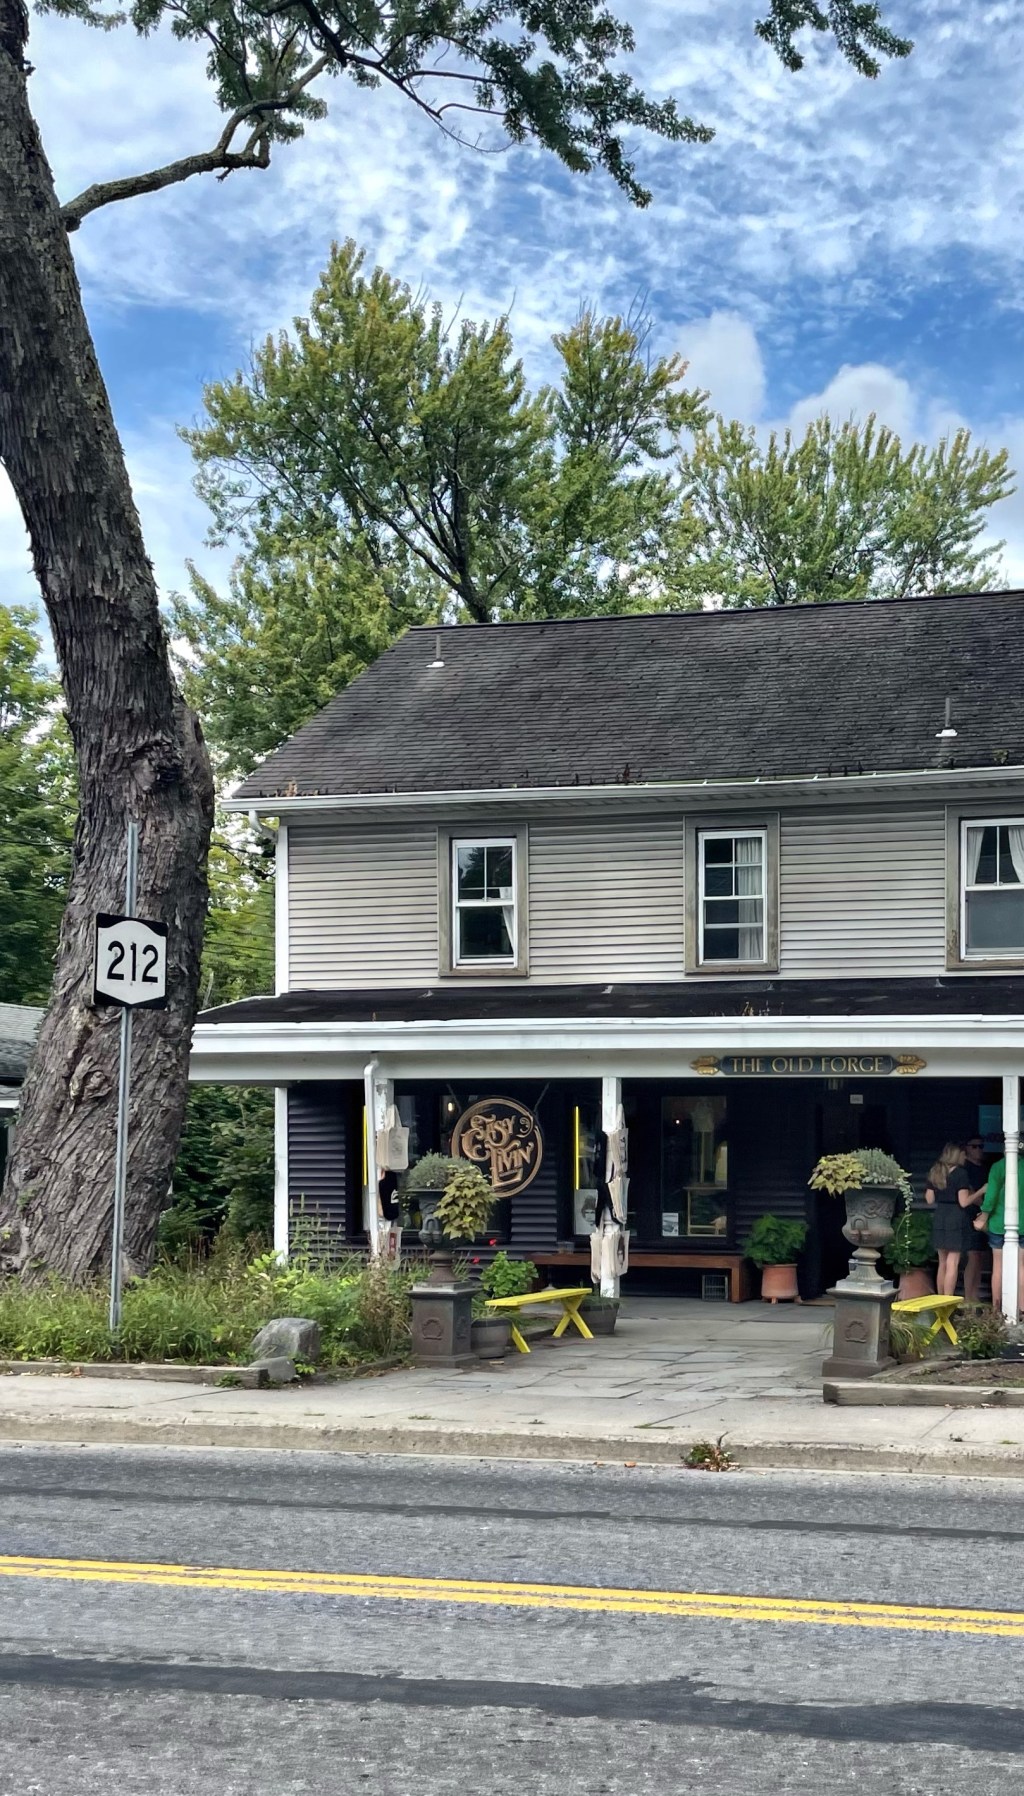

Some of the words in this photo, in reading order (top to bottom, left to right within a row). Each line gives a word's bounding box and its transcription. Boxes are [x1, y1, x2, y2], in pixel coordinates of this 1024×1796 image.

[107, 940, 159, 983] 212
[730, 1057, 765, 1073] THE
[771, 1057, 814, 1073] OLD
[821, 1056, 885, 1073] FORGE
